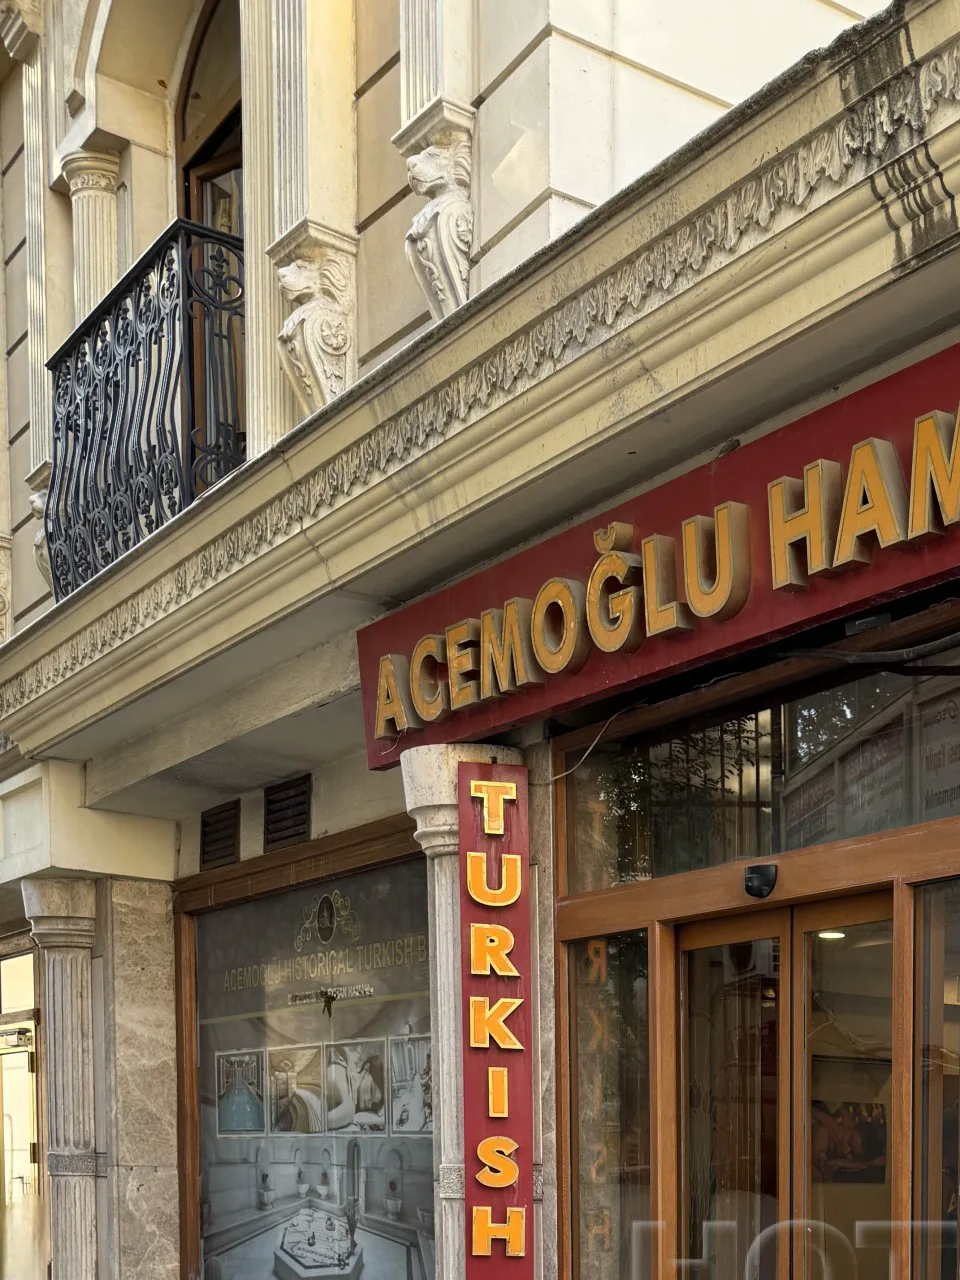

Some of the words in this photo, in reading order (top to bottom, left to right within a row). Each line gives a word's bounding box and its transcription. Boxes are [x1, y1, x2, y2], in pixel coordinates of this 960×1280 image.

[374, 501, 751, 740] ACEMOĞLU
[284, 949, 354, 982] HISTORICAL
[356, 937, 413, 971] TURKISH
[466, 779, 525, 1258] TURKISH
